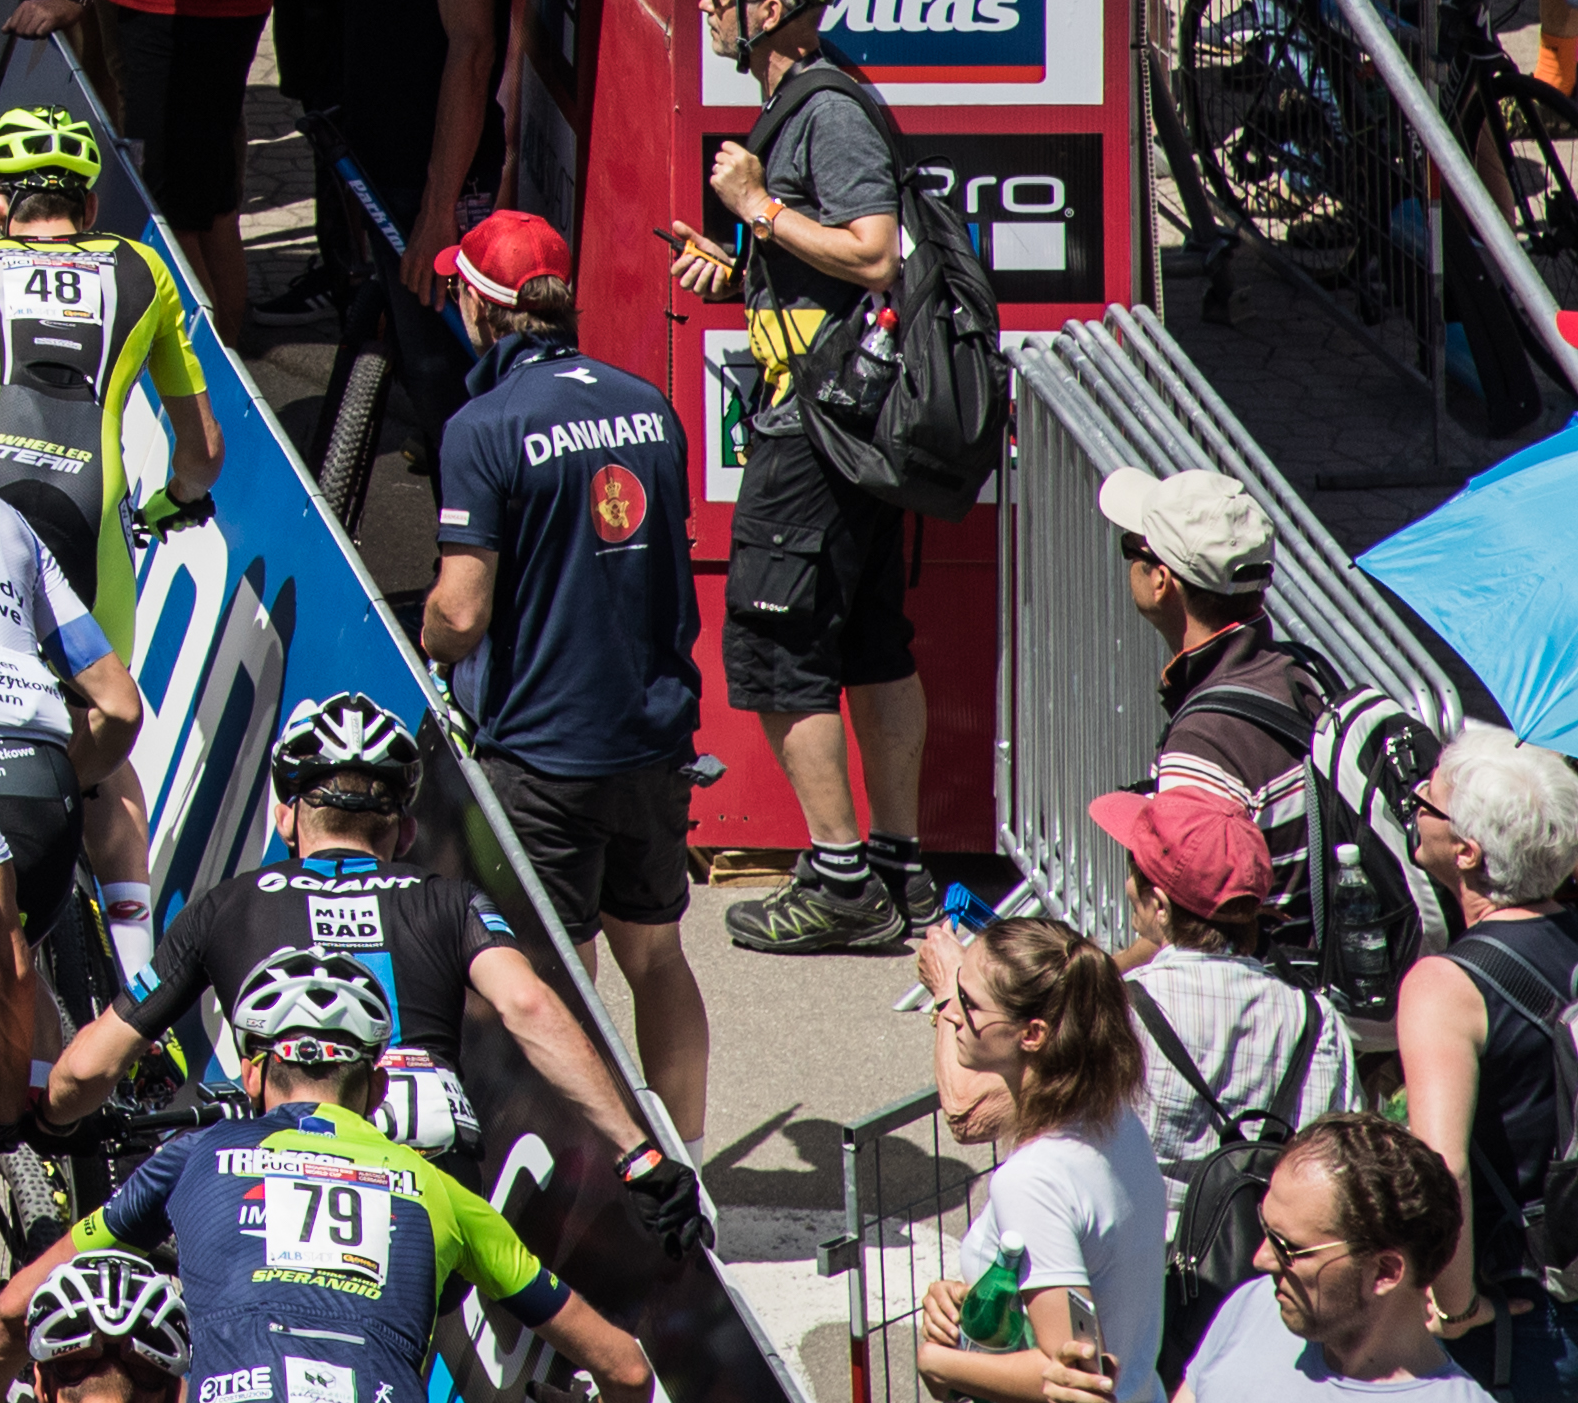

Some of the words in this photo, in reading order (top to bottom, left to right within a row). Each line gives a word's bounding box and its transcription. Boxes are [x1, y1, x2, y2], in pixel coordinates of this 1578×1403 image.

[24, 269, 82, 305] 48
[288, 873, 420, 891] GIANT
[315, 919, 378, 939] BAD
[294, 1184, 363, 1246] 79
